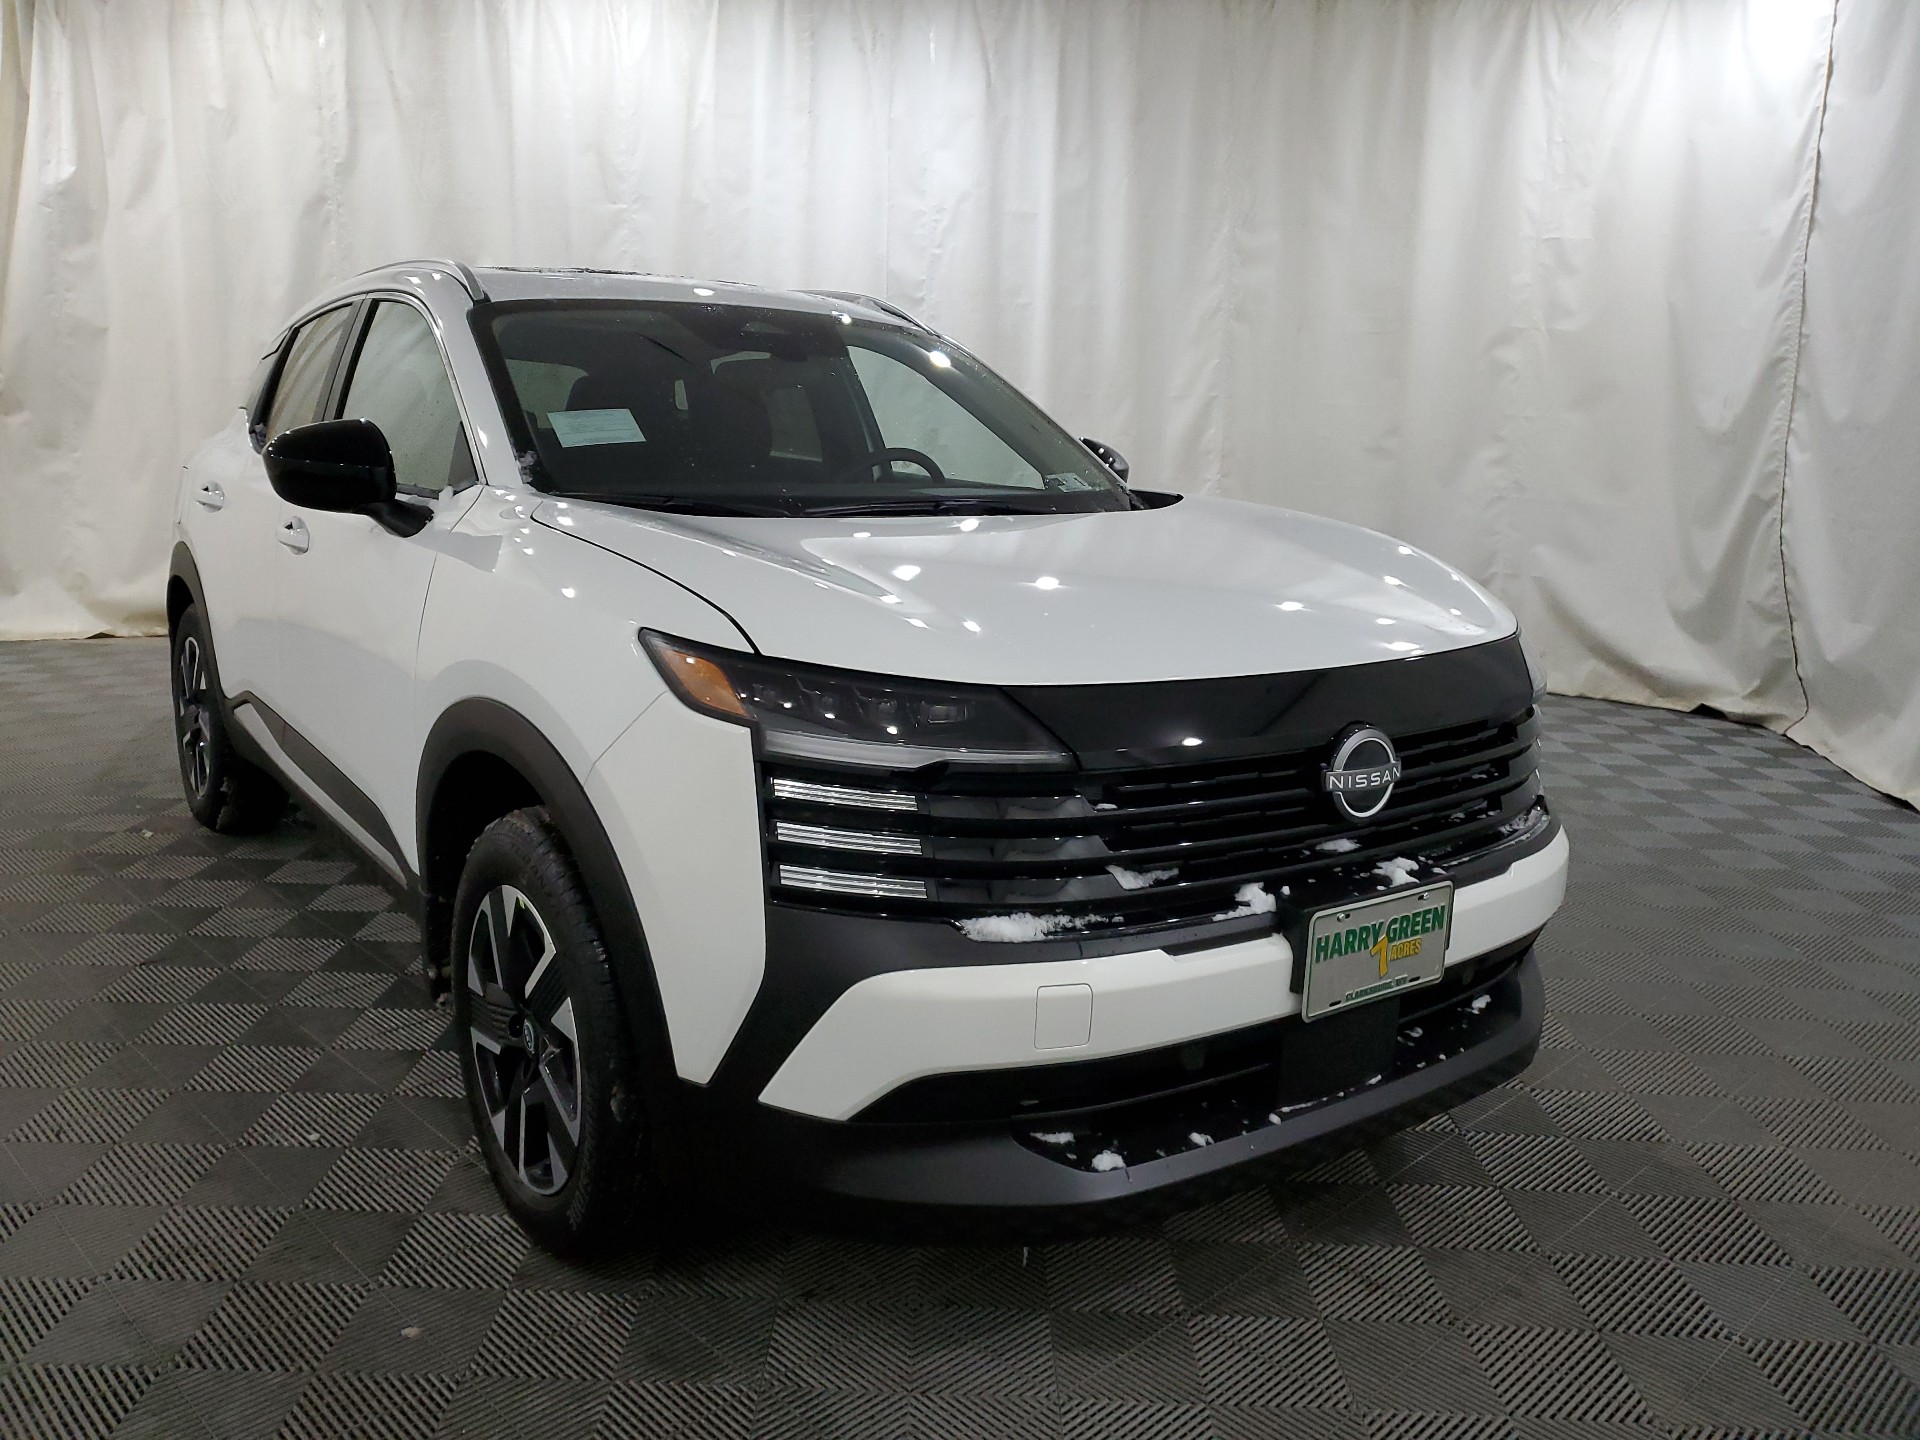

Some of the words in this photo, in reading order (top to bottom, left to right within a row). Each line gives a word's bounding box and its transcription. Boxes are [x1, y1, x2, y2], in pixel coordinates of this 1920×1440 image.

[1329, 766, 1400, 789] NISSAN
[1315, 920, 1384, 964] HARRY
[1386, 905, 1446, 944] GREEN
[1390, 937, 1422, 961] ACRES
